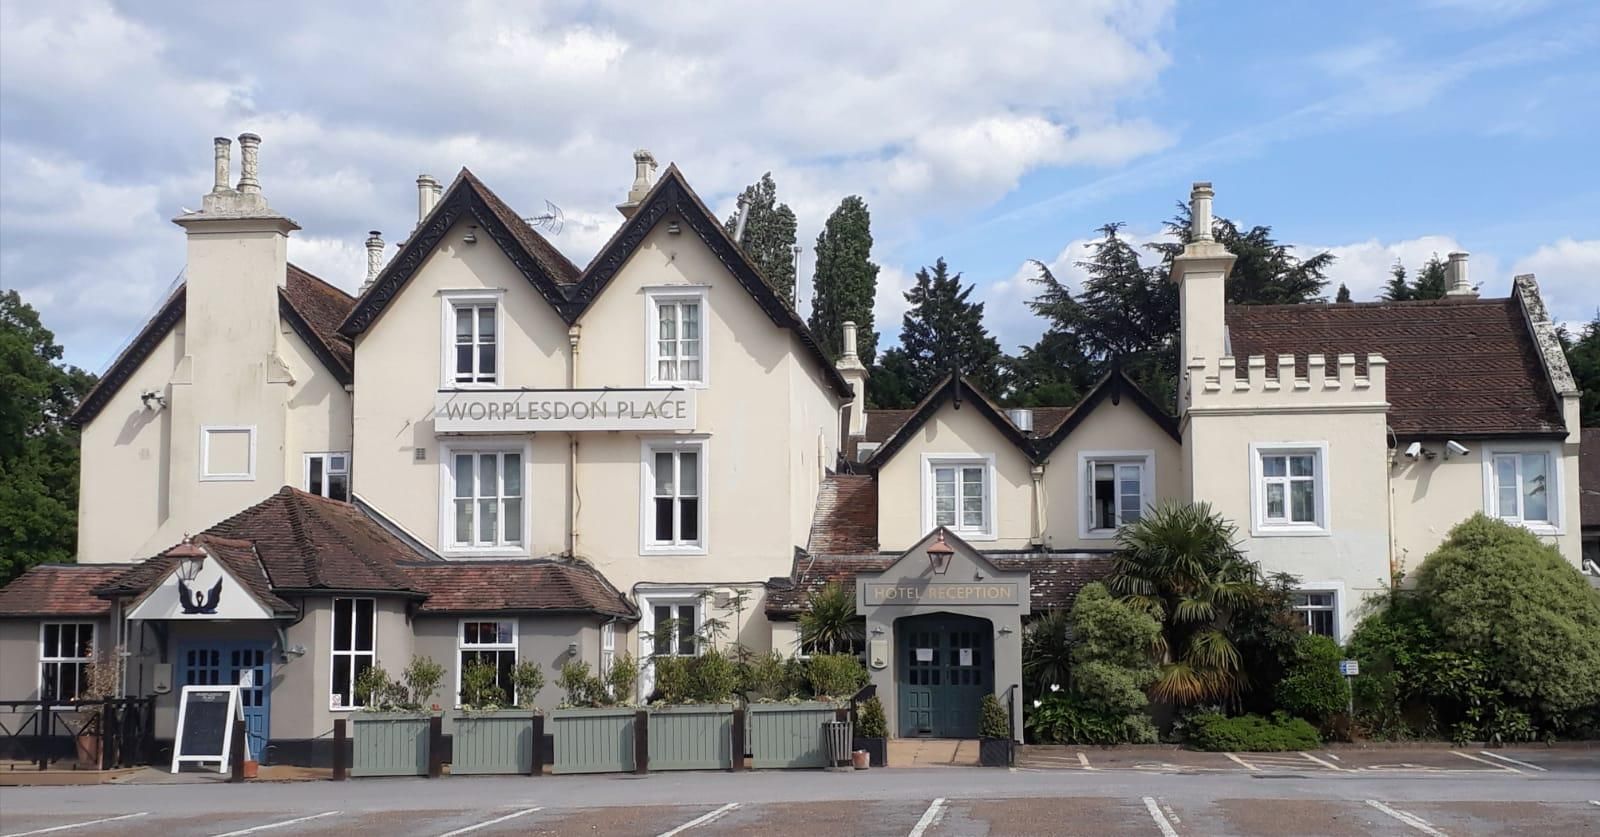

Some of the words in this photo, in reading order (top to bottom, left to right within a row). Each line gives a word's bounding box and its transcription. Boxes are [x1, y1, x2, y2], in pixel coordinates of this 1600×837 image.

[446, 400, 607, 420] WORPLESDON
[616, 400, 687, 419] PLACE
[874, 587, 920, 600] HOTEL
[928, 586, 1010, 599] RECEPTION
